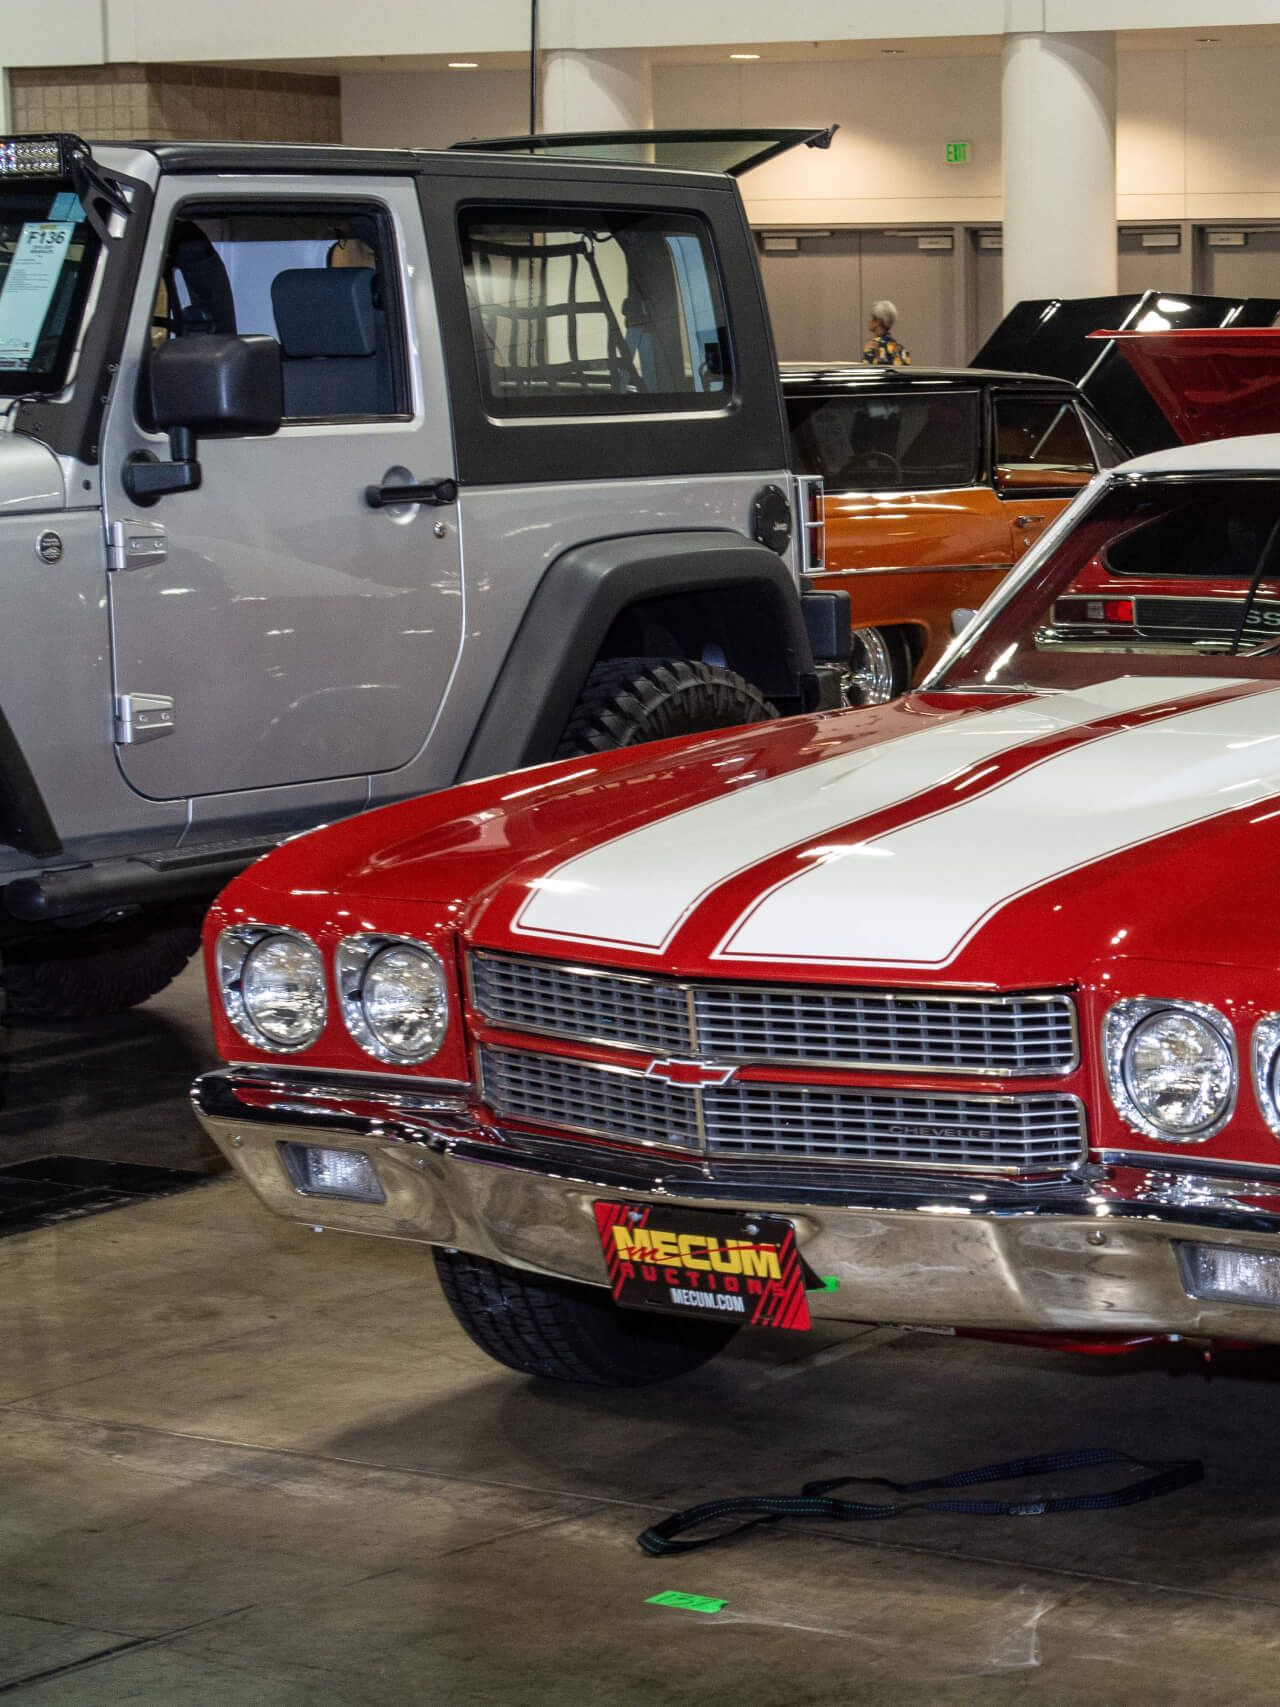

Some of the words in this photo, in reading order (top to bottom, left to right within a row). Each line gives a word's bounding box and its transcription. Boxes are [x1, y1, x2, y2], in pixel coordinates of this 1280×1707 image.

[947, 143, 968, 162] EXIT
[27, 231, 66, 244] F136
[888, 1125, 992, 1138] CHEVELLE
[612, 1225, 782, 1280] MECUM
[619, 1262, 786, 1299] AUCTIONS
[670, 1287, 746, 1313] MECUM.COM
